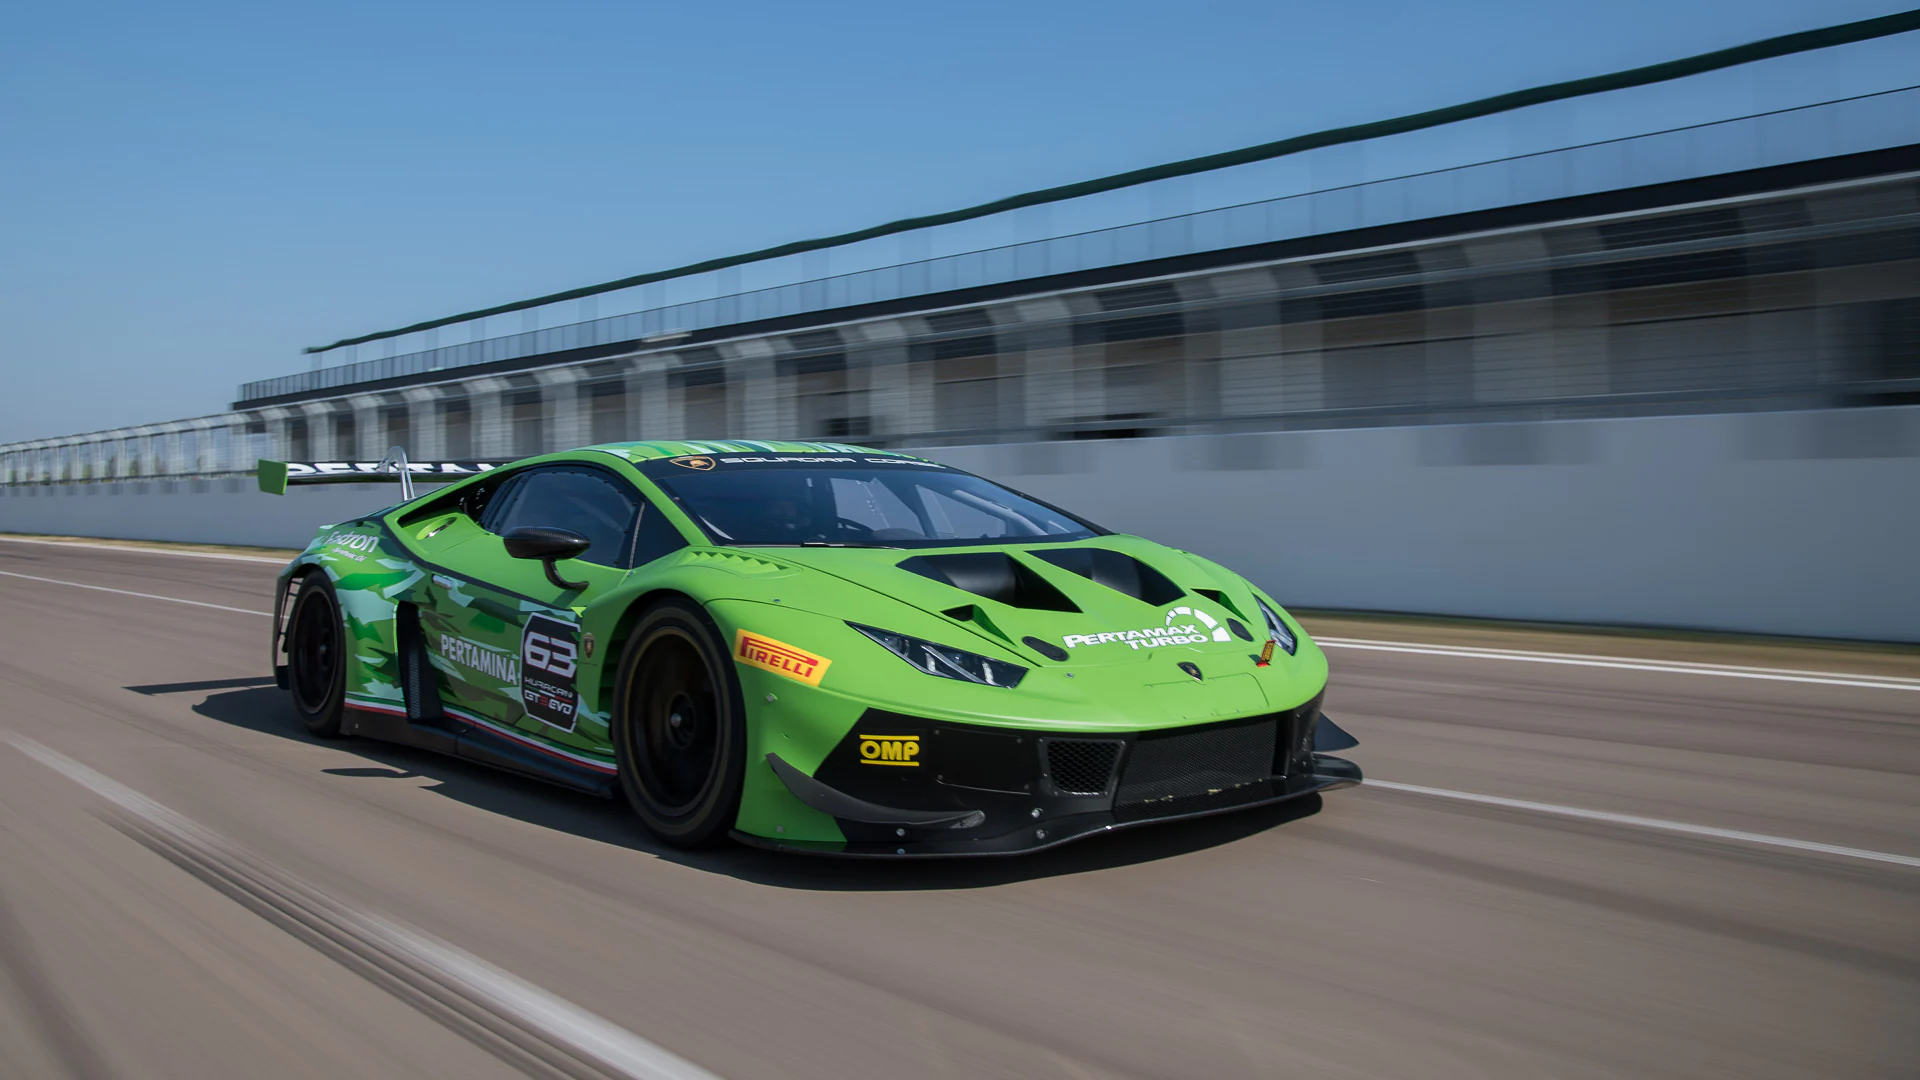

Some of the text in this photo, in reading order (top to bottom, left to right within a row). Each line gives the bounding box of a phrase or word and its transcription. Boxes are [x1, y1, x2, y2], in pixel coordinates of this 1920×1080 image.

[286, 462, 507, 476] PERTA
[1062, 624, 1199, 649] PERTAMAX
[1123, 634, 1208, 650] TURBO
[441, 633, 518, 685] PERTAMINA
[524, 631, 577, 678] 63
[740, 636, 819, 678] PIRELLI
[859, 740, 920, 761] OMP
